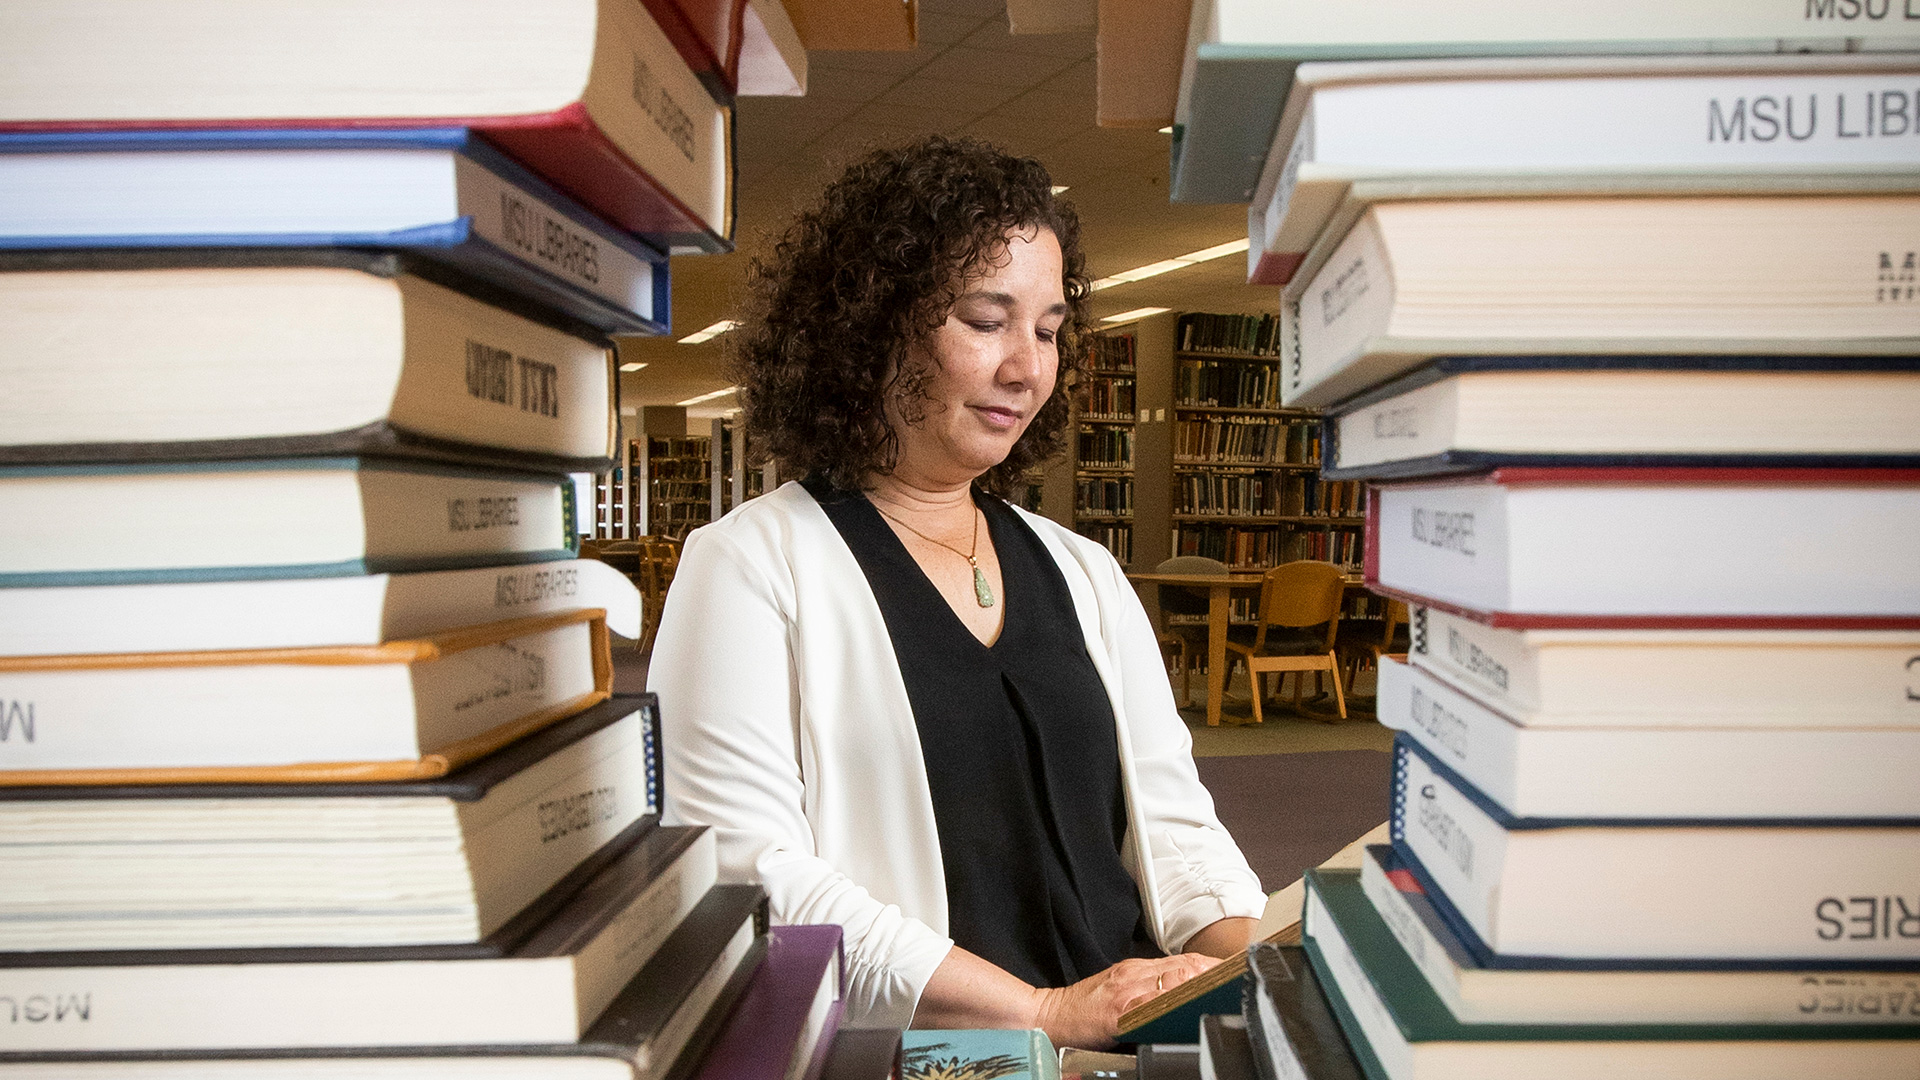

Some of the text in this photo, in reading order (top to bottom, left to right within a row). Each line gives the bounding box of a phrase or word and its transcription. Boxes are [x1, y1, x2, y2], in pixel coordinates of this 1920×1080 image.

[1709, 89, 1920, 142] MSU LIB
[501, 191, 599, 284] MSU LIBRARIES
[523, 569, 577, 602] LIBRARIES
